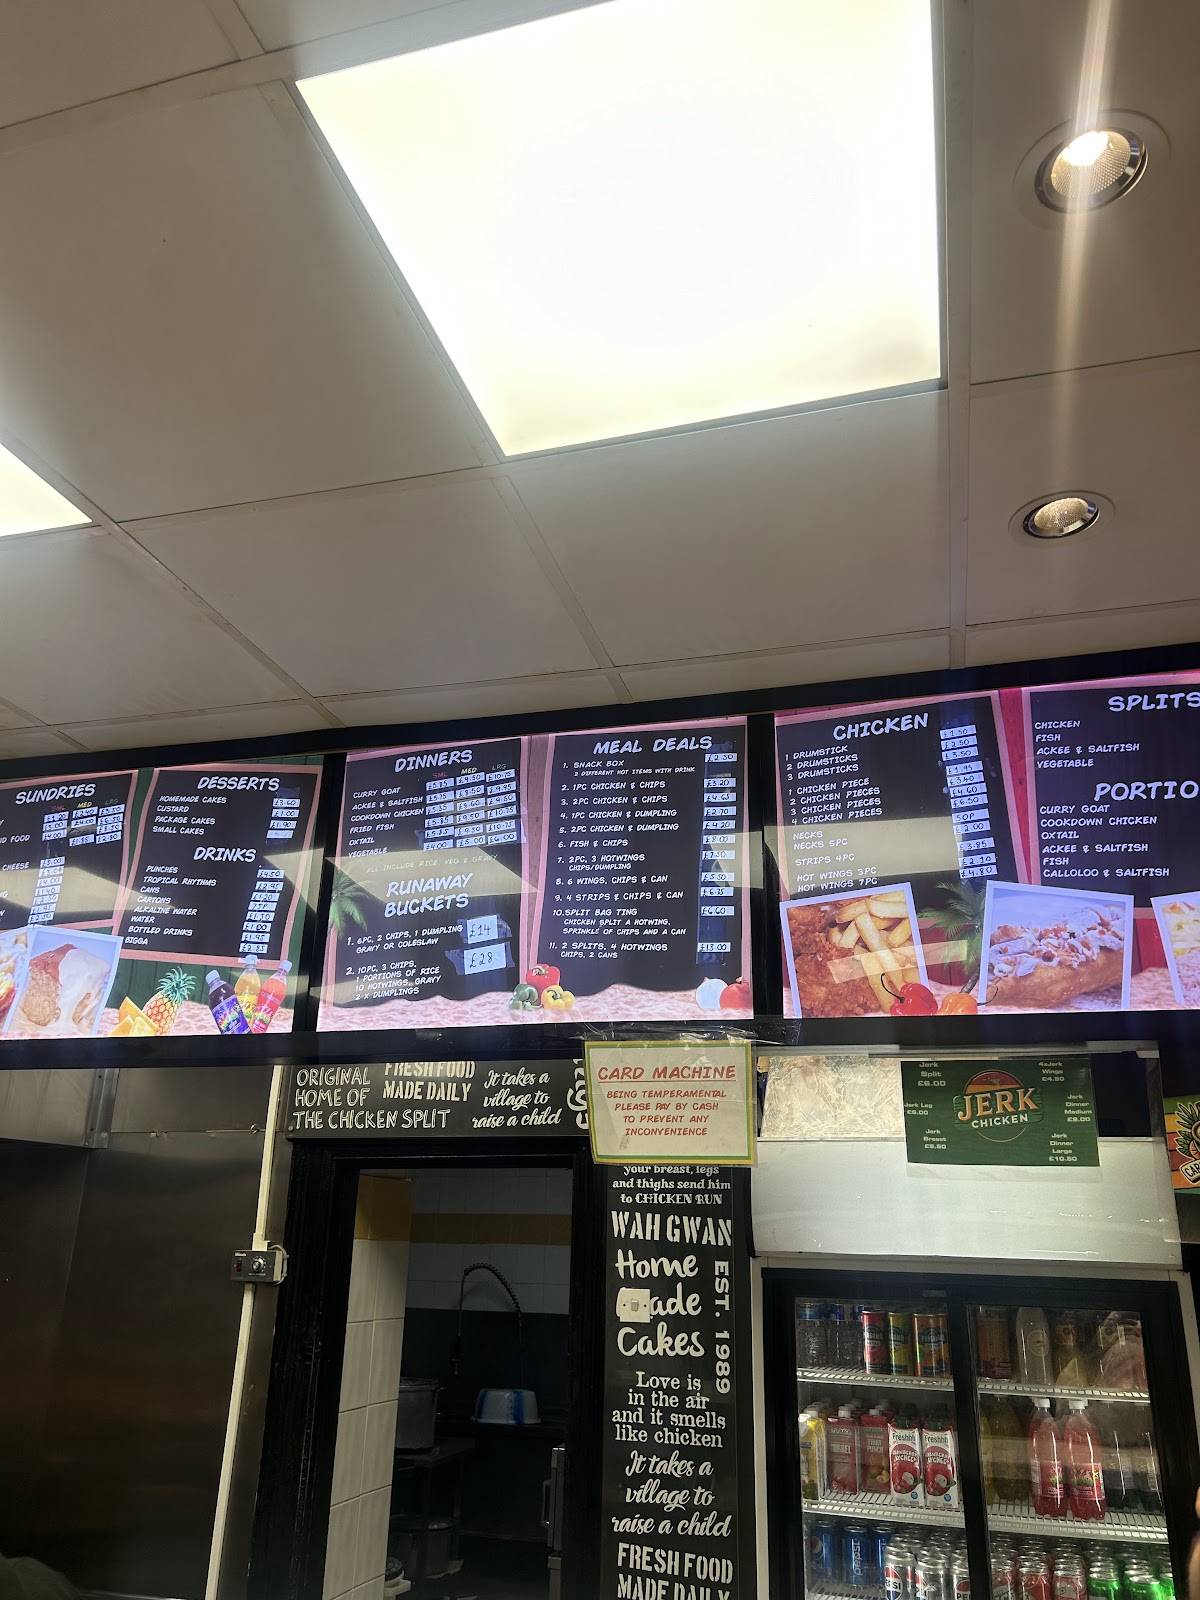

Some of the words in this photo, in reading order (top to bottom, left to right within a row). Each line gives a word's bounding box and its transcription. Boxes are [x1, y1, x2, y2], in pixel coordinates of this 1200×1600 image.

[1108, 691, 1200, 712] SPLITS
[832, 712, 929, 741] CHICKEN
[1034, 720, 1081, 730] CHICKEN
[593, 739, 643, 755] MEAL
[652, 735, 713, 752] DEALS
[1035, 734, 1061, 742] FISH
[793, 745, 849, 760] DRUMSTICK
[1036, 746, 1071, 755] ACKEE
[1087, 743, 1140, 754] SALTFISH
[394, 749, 473, 773] DINNERS
[786, 763, 793, 771] 2
[796, 753, 859, 770] DRUMSTICKS
[1037, 759, 1094, 769] VEGETABLE
[786, 773, 793, 781] 3
[797, 764, 860, 780] DRUMSTICKS
[197, 776, 281, 792] DESSERTS
[353, 788, 378, 799] CURRY
[381, 786, 401, 796] GOAT
[572, 782, 587, 791] 1PC
[590, 781, 626, 791] CHICKEN
[639, 780, 666, 789] CHIPS
[15, 783, 97, 805] SUNDRIES
[159, 795, 200, 804] HOMEMADE
[202, 796, 227, 804] CAKES
[789, 798, 796, 806] 2
[800, 792, 841, 806] CHICKEN
[845, 787, 881, 800] PIECES
[156, 805, 190, 813] CUSTARD
[1039, 805, 1076, 815] CURRY
[1081, 804, 1111, 814] GOAT
[349, 824, 373, 835] FRIED
[375, 822, 395, 832] FISH
[1040, 818, 1103, 828] COOKDOWN
[1108, 816, 1158, 826] CHICKEN
[1040, 831, 1080, 840] OXTAIL
[193, 846, 257, 863] DRINKS
[1041, 844, 1077, 854] ACKEE
[1094, 843, 1149, 853] SALTFISH
[145, 865, 178, 874] PUNCHES
[1042, 857, 1069, 866] FISH
[1043, 868, 1099, 878] CALLOLOO
[1115, 868, 1170, 878] SALTFISH
[386, 872, 474, 899] RUNAWAY
[384, 893, 470, 918] BUCKETS
[130, 915, 156, 924] WATER
[128, 925, 161, 934] BOTTLED
[163, 928, 193, 937] DRINKS
[469, 924, 492, 938] £14
[356, 943, 380, 954] GRAVY
[383, 941, 394, 950] OR
[397, 936, 439, 949] COLESLAW
[469, 951, 493, 968] £28
[296, 1067, 371, 1087] ORIGINAL
[484, 1070, 500, 1089] It
[501, 1067, 537, 1087] takes
[538, 1073, 550, 1084] a
[598, 1066, 645, 1080] CARD
[652, 1065, 736, 1080] MACHINE
[920, 1070, 942, 1078] Split
[295, 1088, 342, 1107] HOME
[347, 1087, 371, 1106] OF
[382, 1080, 425, 1100] MADE
[426, 1081, 472, 1102] DAILY
[607, 1090, 638, 1099] BEING
[642, 1089, 727, 1098] TEMPERAMENTAL
[483, 1088, 532, 1112] village
[533, 1090, 550, 1105] to
[614, 1102, 651, 1111] PLEASE
[655, 1102, 671, 1111] PAY
[675, 1102, 688, 1111] BY
[692, 1102, 719, 1110] CASH
[957, 1086, 1040, 1122] JERK
[292, 1110, 324, 1130] THE
[327, 1109, 399, 1130] CHICKEN
[401, 1108, 451, 1130] SPLIT
[472, 1113, 504, 1130] raise
[505, 1114, 518, 1127] a
[520, 1106, 563, 1126] child
[623, 1115, 635, 1123] TO
[639, 1115, 684, 1123] PREVENT
[689, 1114, 709, 1123] ANY
[971, 1112, 1029, 1129] CHICKEN
[625, 1127, 708, 1137] INCONVENIENCE
[623, 1166, 652, 1176] your
[653, 1165, 694, 1175] breast,
[612, 1178, 634, 1189] and
[636, 1178, 675, 1191] thighs
[676, 1179, 705, 1190] send
[706, 1179, 731, 1190] him
[620, 1193, 633, 1203] to
[635, 1192, 693, 1204] CHICKEN
[694, 1194, 723, 1205] RUN
[611, 1210, 661, 1241] WAH
[666, 1214, 732, 1246] GWAN
[615, 1249, 699, 1279] Home
[714, 1260, 730, 1318] EST.
[617, 1321, 705, 1357] Cakes
[715, 1330, 731, 1394] 1989
[635, 1371, 681, 1390] Love
[687, 1374, 702, 1391] is
[628, 1388, 645, 1406] in
[651, 1390, 679, 1408] the
[685, 1393, 710, 1410] air
[612, 1407, 644, 1424] and
[650, 1408, 663, 1425] it
[670, 1411, 726, 1429] smells
[615, 1424, 648, 1443] like
[654, 1427, 723, 1448] chicken
[625, 1450, 647, 1477] It
[648, 1450, 694, 1478] takes
[699, 1461, 714, 1476] a
[625, 1478, 691, 1512] village
[692, 1485, 715, 1506] to
[611, 1514, 656, 1535] raise
[657, 1520, 674, 1534] a
[677, 1511, 733, 1537] child
[617, 1542, 680, 1576] FRESH
[683, 1552, 734, 1585] FOOD
